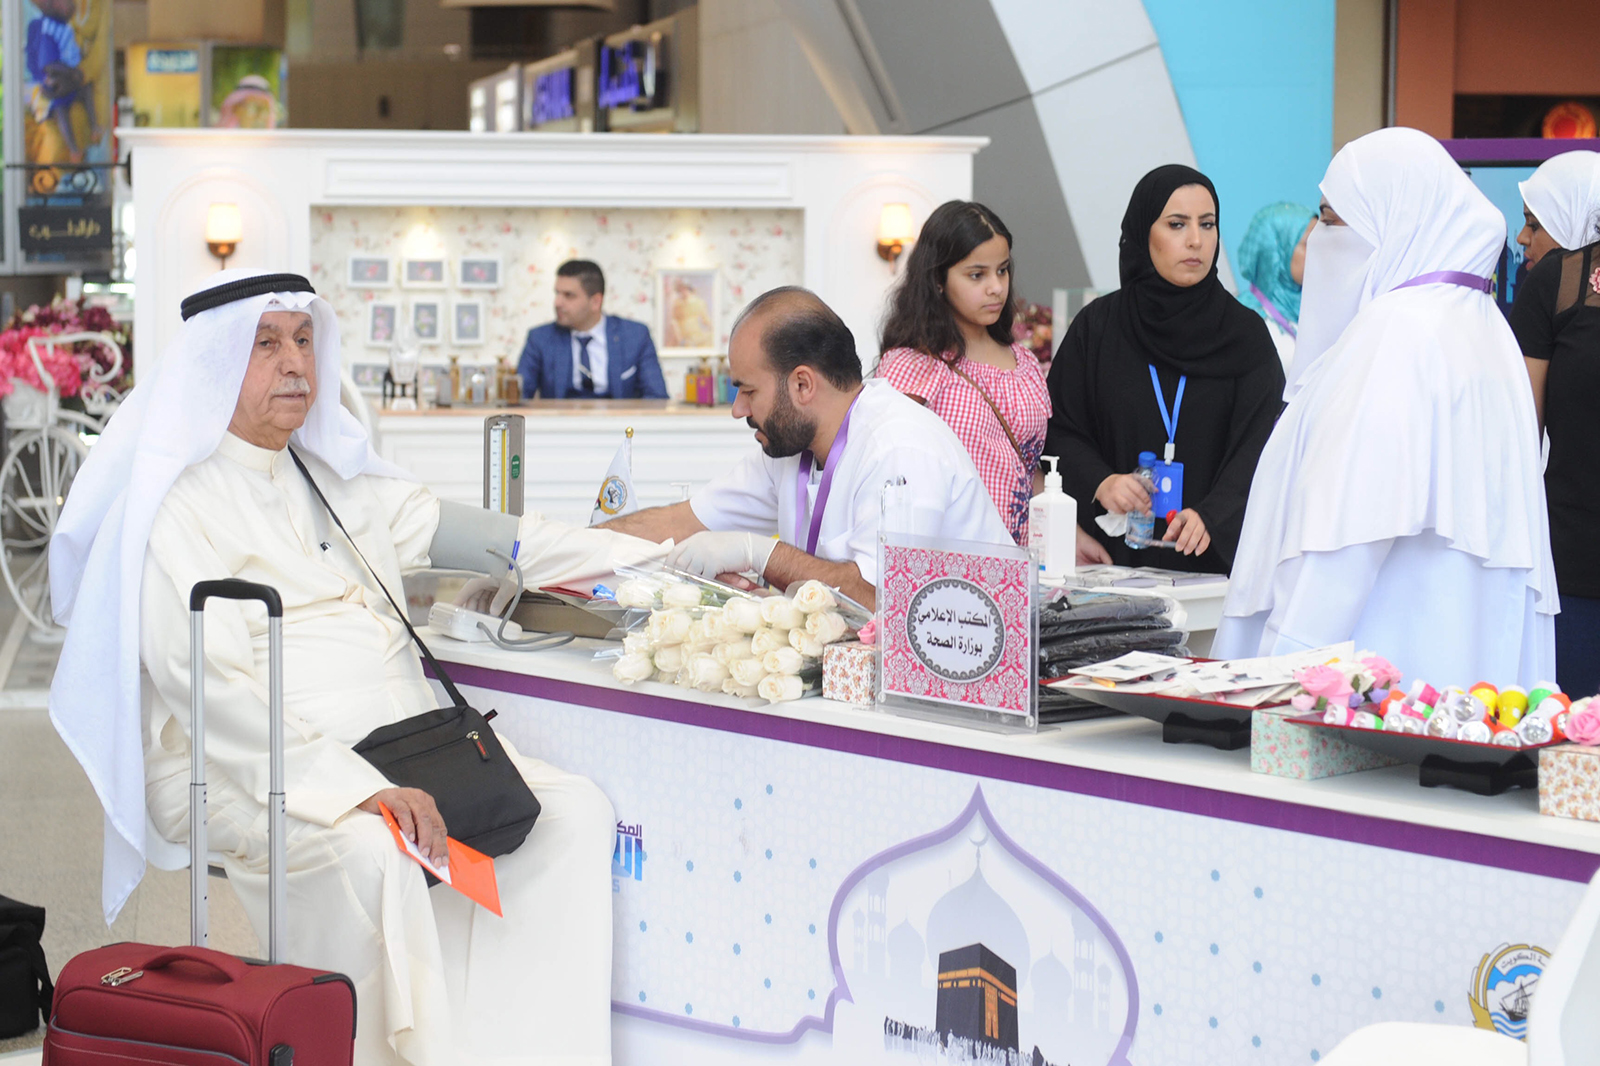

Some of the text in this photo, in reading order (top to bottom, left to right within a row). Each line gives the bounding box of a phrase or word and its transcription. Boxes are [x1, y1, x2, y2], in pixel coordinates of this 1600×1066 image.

[918, 607, 991, 629] المكتب الإعلامي
[927, 631, 983, 657] بوزارة الصحة
[1501, 953, 1536, 968] الكويت
